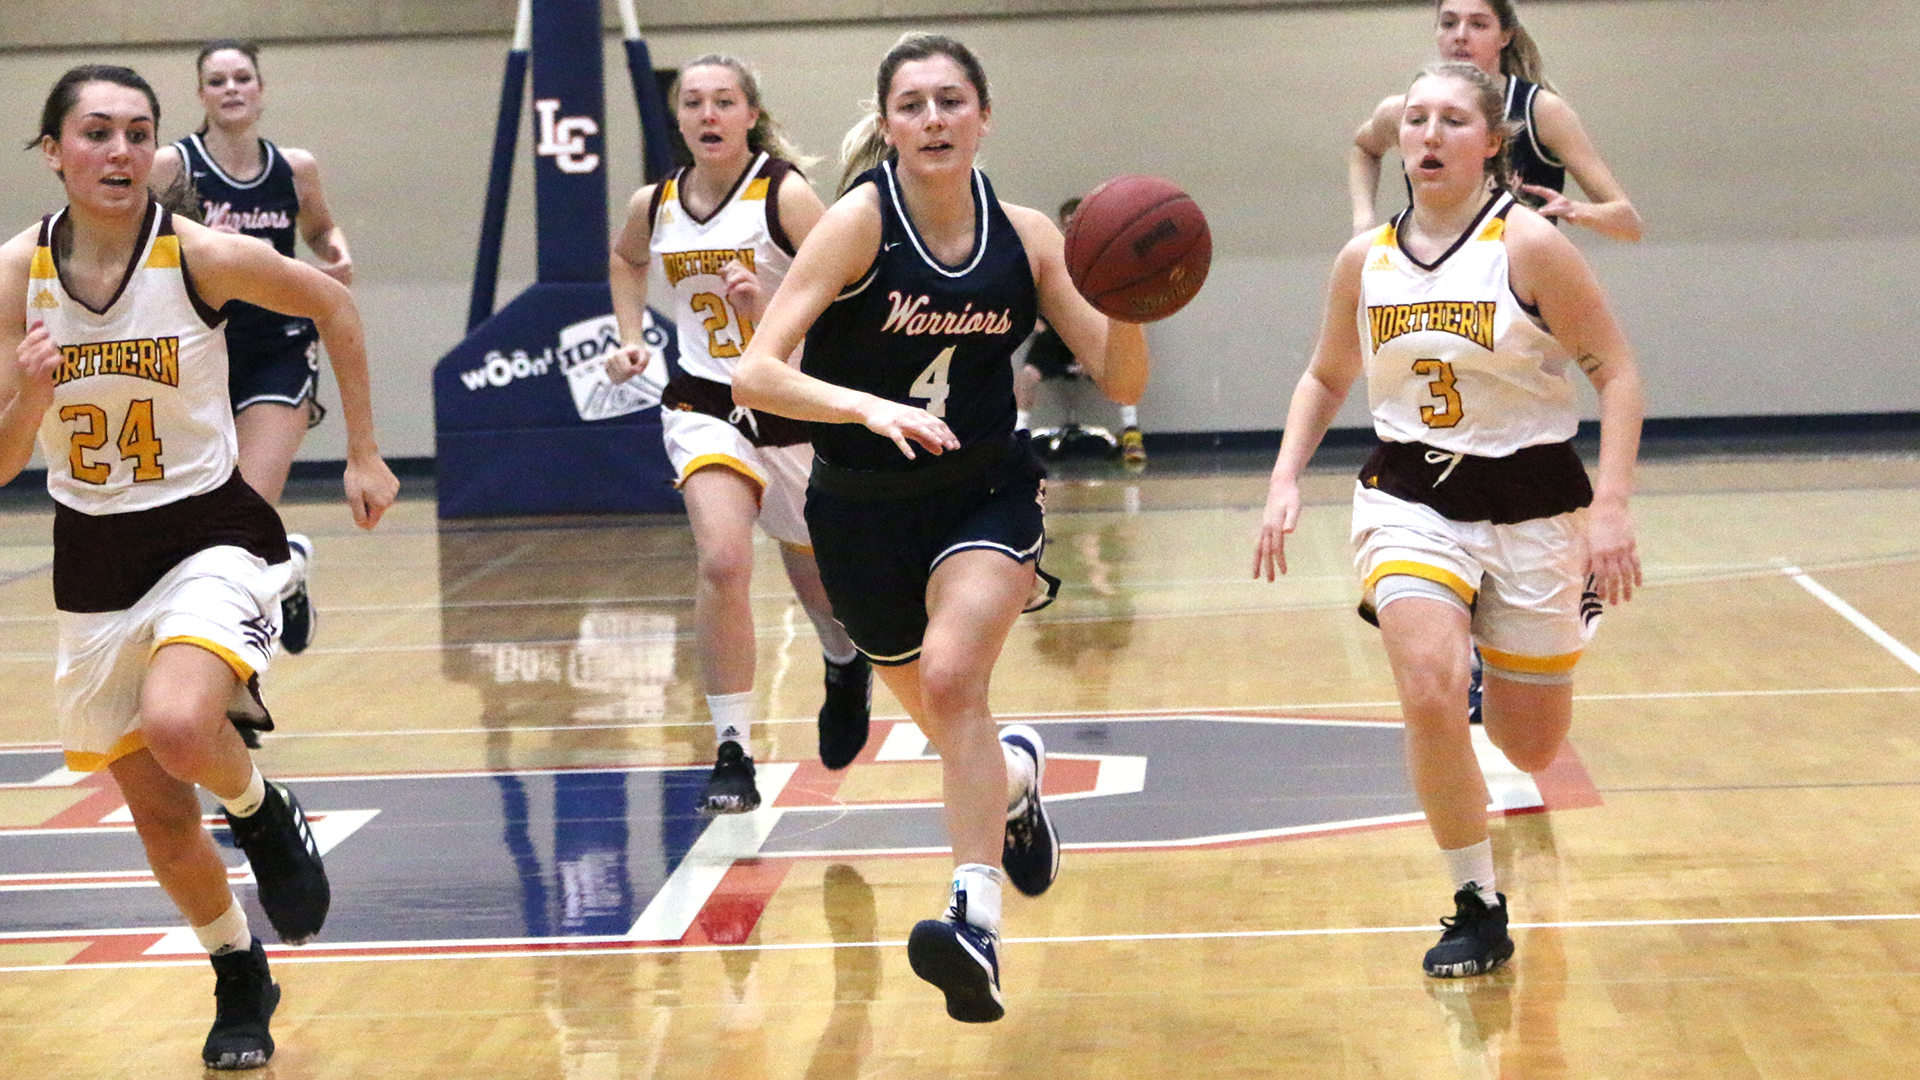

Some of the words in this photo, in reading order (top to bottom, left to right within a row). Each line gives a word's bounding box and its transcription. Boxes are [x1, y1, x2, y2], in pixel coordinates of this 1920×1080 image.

[535, 99, 599, 174] LC
[880, 290, 1013, 337] Warriors
[1367, 300, 1497, 356] NORTHERN
[53, 335, 180, 389] RTHERN
[908, 345, 958, 419] 4
[1411, 358, 1465, 429] 3
[59, 397, 165, 486] 24
